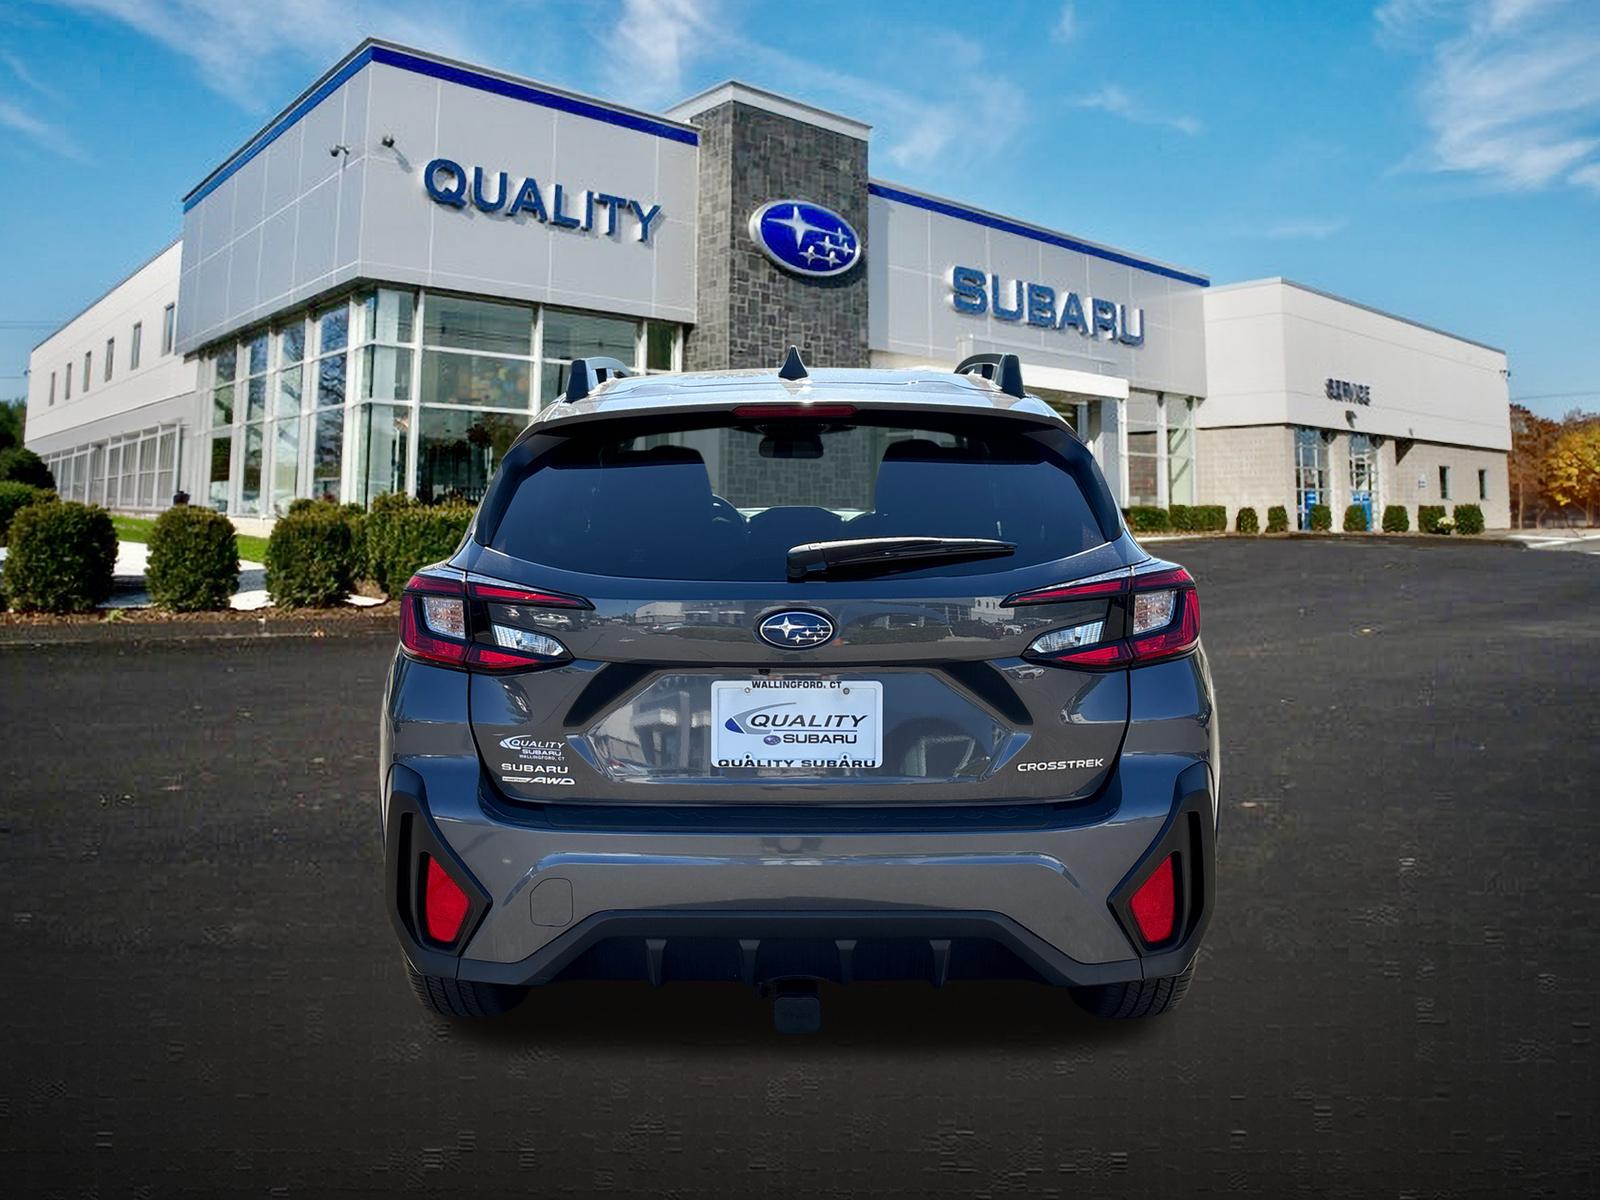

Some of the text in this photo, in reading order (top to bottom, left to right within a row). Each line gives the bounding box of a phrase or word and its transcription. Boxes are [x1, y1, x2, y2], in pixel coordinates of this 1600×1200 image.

[423, 157, 663, 243] QUALITY
[948, 265, 1146, 347] SUBARU
[829, 680, 842, 689] CT
[750, 714, 867, 728] QUALITY
[511, 739, 565, 748] QUALITY
[782, 733, 858, 745] SUBARU
[501, 763, 568, 774] SUBARU
[718, 759, 876, 768] QUALITY SUBARU
[1017, 758, 1104, 772] CROSSTREK
[530, 776, 575, 785] AWD
